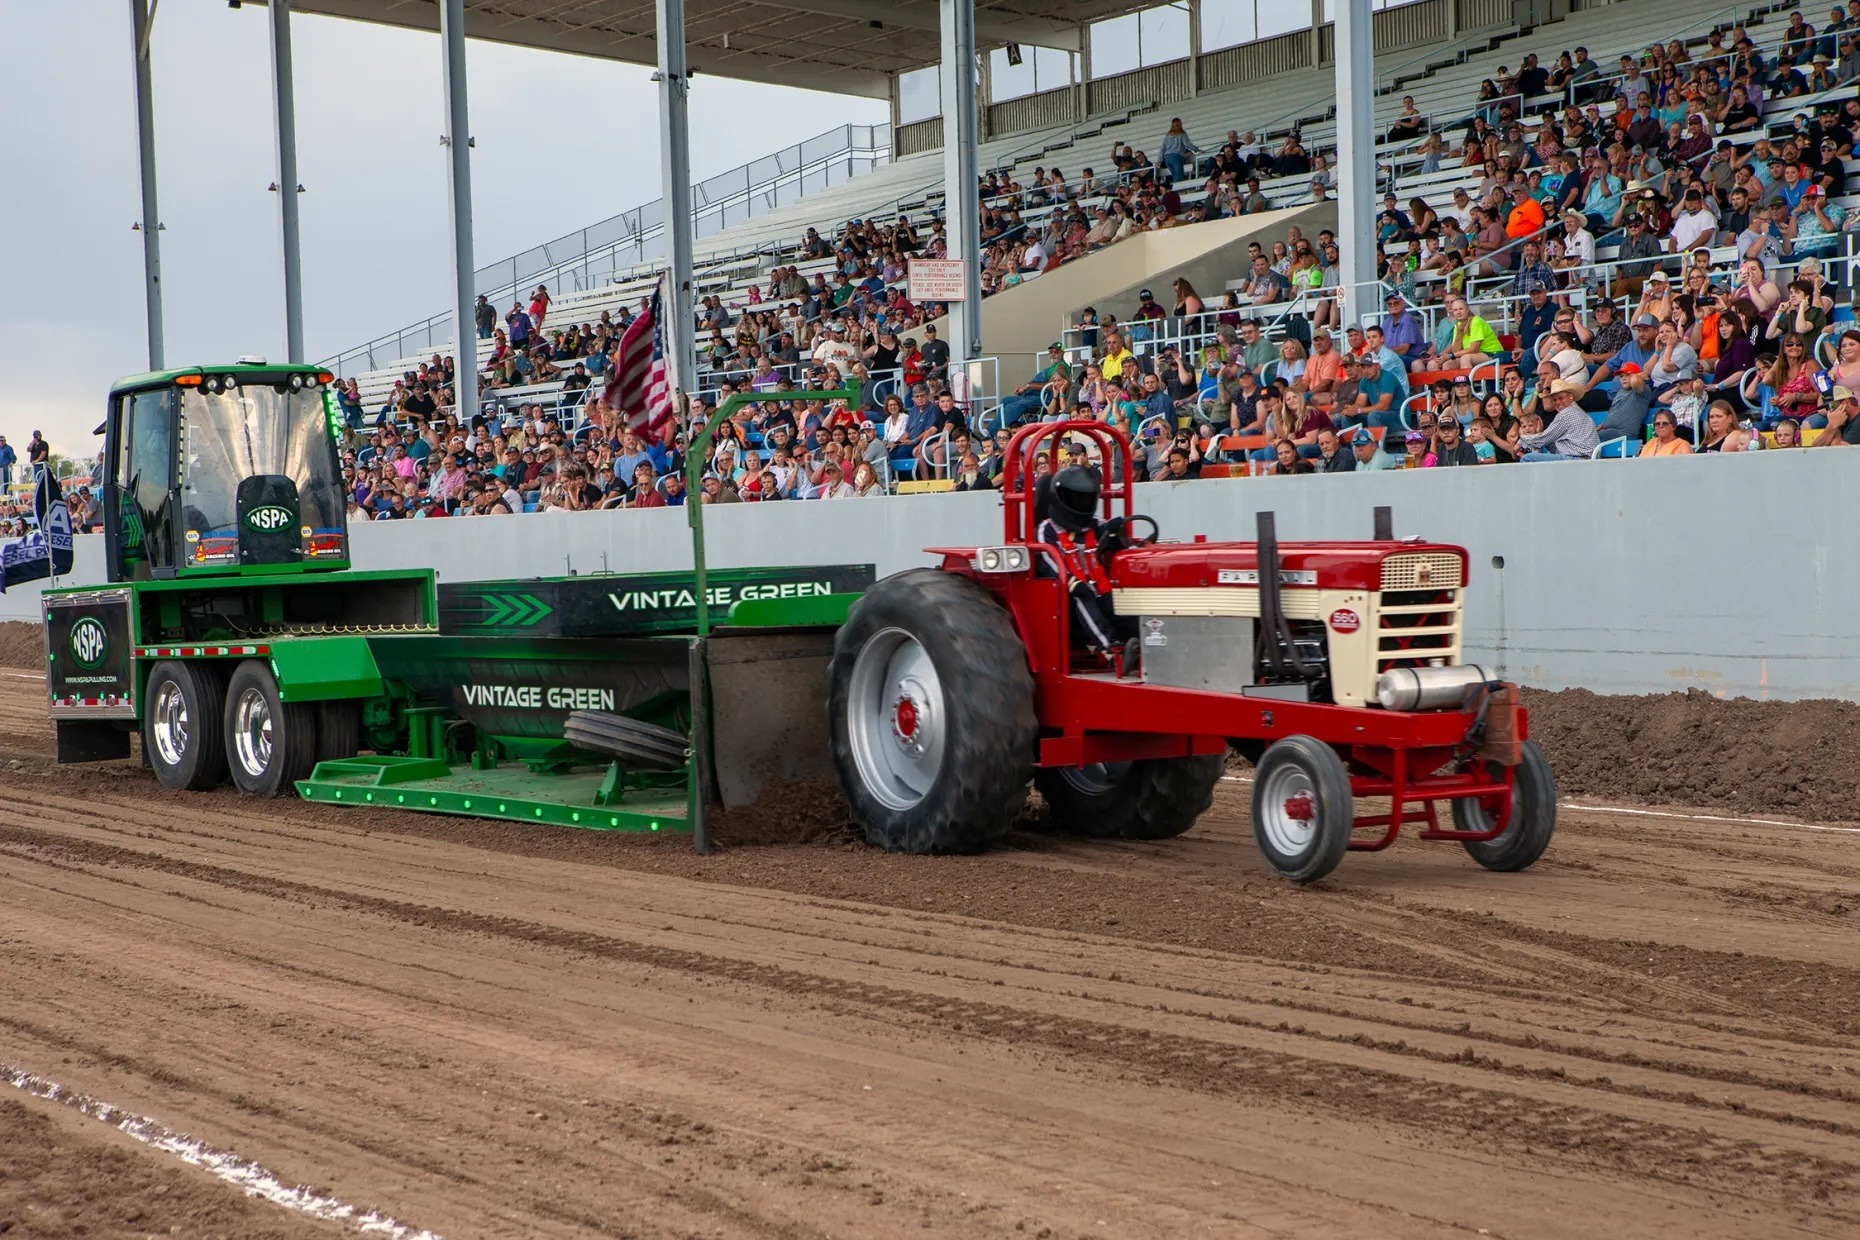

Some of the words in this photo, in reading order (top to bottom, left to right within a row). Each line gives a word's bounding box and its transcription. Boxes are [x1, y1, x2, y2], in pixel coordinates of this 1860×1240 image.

[250, 509, 289, 529] NSPA
[740, 581, 832, 600] GREEN
[1332, 612, 1358, 623] 560
[73, 623, 104, 662] NSPA
[462, 685, 542, 708] VINTAGE
[547, 687, 615, 711] GREEN
